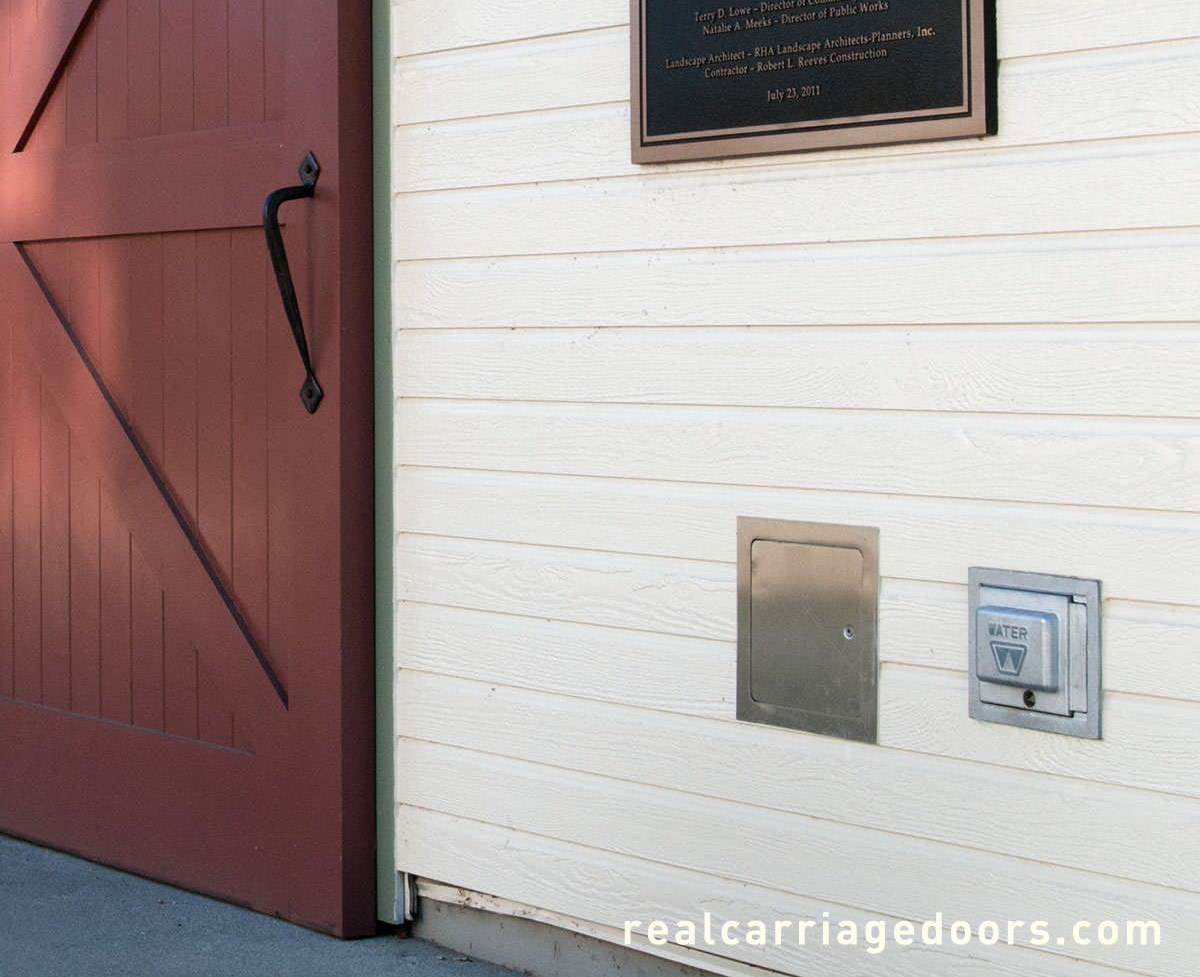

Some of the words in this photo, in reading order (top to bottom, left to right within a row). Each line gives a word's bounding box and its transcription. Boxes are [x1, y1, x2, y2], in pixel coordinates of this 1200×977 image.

[694, 11, 715, 23] Terry
[729, 7, 751, 17] Lowe
[760, 0, 795, 13] Director
[703, 24, 732, 35] Natalie
[745, 17, 772, 29] Meeks
[781, 10, 816, 24] Director
[818, 7, 828, 19] of
[829, 3, 857, 17] Public
[860, 0, 889, 13] Works
[665, 56, 706, 69] Landscape
[708, 50, 745, 64] Architect
[754, 46, 775, 57] RHA
[777, 40, 821, 55] Landscape
[917, 26, 936, 37] Inc.
[704, 65, 748, 78] Contractor
[757, 59, 785, 72] Robert
[798, 55, 828, 68] Reeves
[829, 48, 888, 64] Construction
[767, 88, 784, 102] July
[787, 87, 800, 99] 23,
[801, 85, 821, 97] 2011
[987, 622, 1028, 640] WATER
